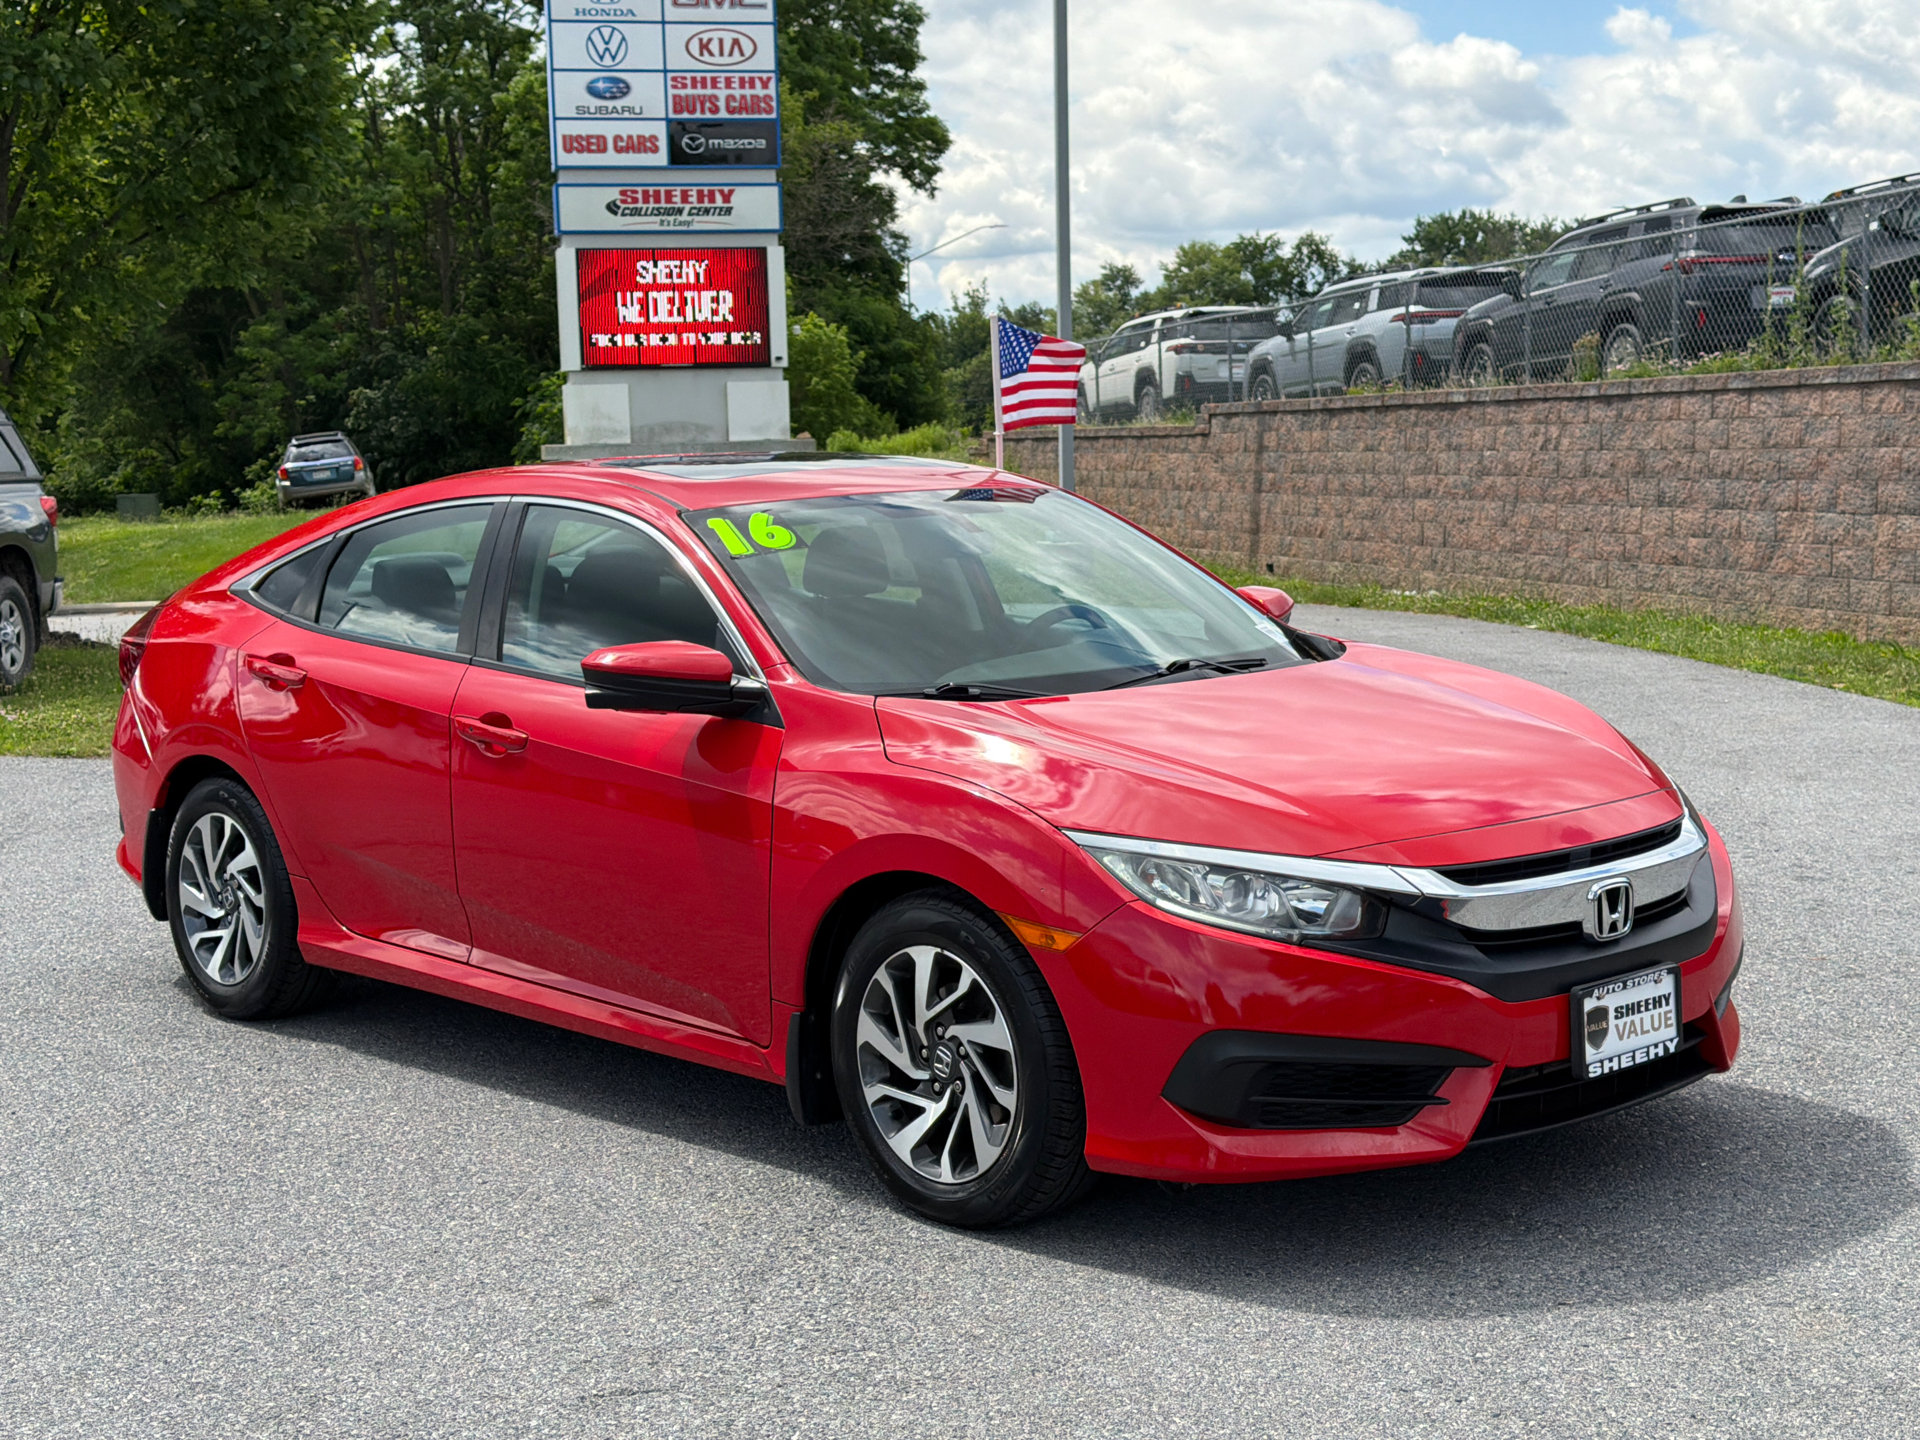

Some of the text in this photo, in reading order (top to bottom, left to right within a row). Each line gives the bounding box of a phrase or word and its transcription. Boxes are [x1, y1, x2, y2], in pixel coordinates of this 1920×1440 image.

[574, 8, 637, 17] HONDA
[697, 37, 746, 57] KIA
[671, 76, 773, 90] SHEEHY
[575, 106, 643, 115] SUBARU
[673, 94, 774, 115] BUYS CARS
[562, 134, 659, 154] USED CARS
[708, 138, 767, 149] mazda
[618, 188, 736, 205] SHEEHY
[620, 206, 734, 217] COLLISION CENTER
[659, 218, 694, 228] It's Easy!
[636, 259, 709, 284] SHEEHY
[617, 291, 644, 323] WE
[707, 512, 797, 555] 16
[1592, 969, 1668, 998] AUTO STORES
[1614, 992, 1672, 1020] SHEEHY
[1586, 1020, 1608, 1032] VALUE
[1614, 1009, 1674, 1041] VALUE
[1588, 1037, 1680, 1078] SHEEHY
